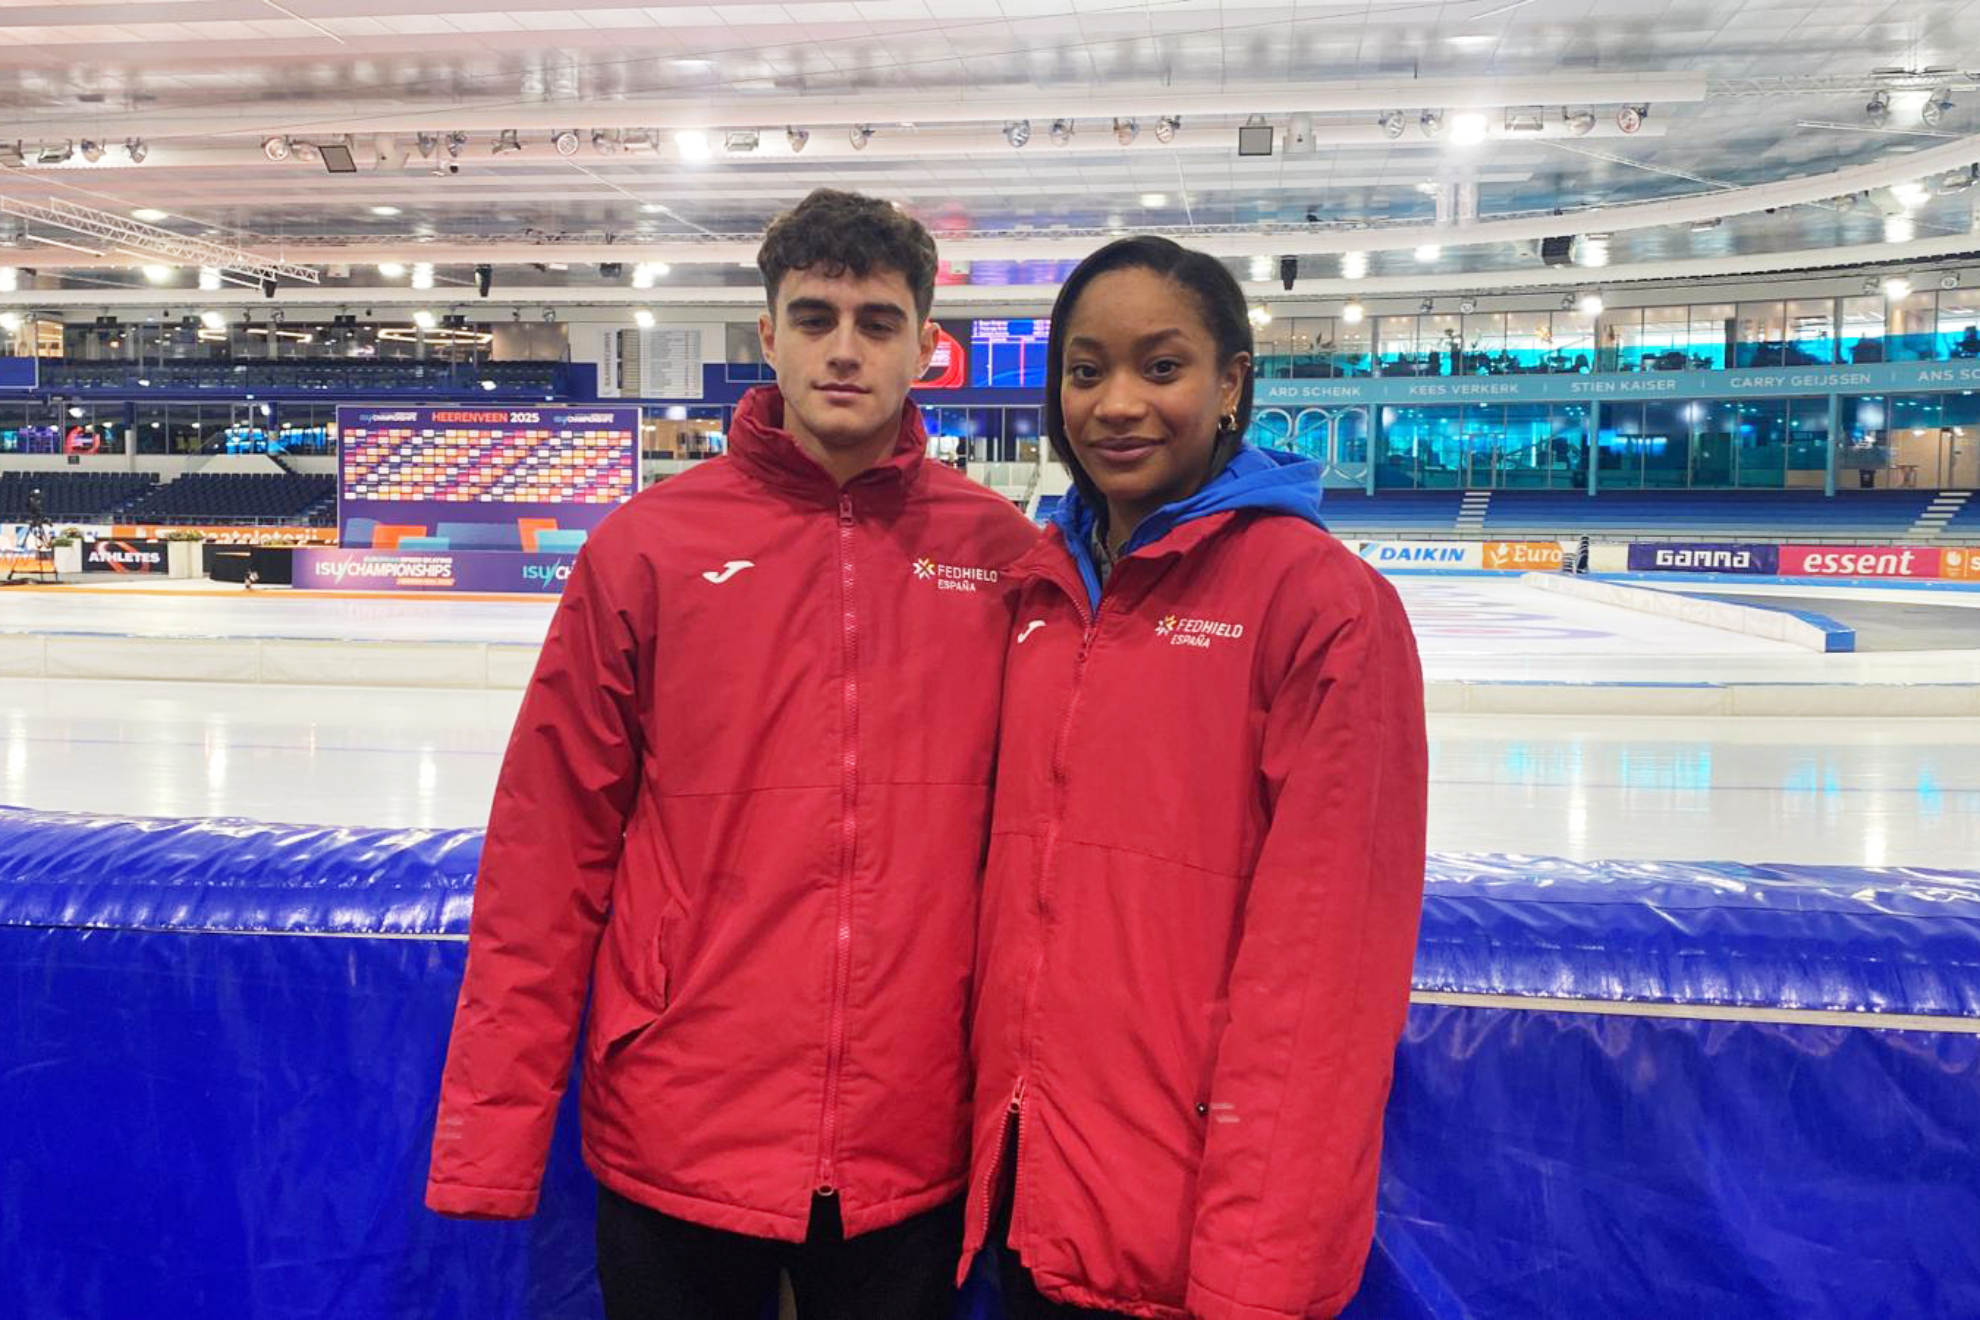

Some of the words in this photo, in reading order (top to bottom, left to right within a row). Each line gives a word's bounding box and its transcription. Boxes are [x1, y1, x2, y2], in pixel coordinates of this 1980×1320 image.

[1730, 376, 1786, 388] CARRY
[1791, 373, 1871, 387] GEIJSSEN
[1918, 370, 1954, 381] ANS
[1269, 386, 1298, 397] ARD
[1301, 386, 1361, 397] SCHENK
[1410, 385, 1446, 396] KEES
[1451, 383, 1519, 395] VERKERK
[1571, 381, 1615, 393] STIEN
[1620, 379, 1676, 392] KAISER
[431, 411, 508, 423] HEERENVEEN
[510, 411, 540, 423] 2025
[88, 552, 160, 563] ATHLETES
[1379, 546, 1465, 562] DAIKIN
[1803, 550, 1915, 576] essent
[938, 564, 998, 583] FEDHIELO
[938, 579, 976, 592] ESPAÑA
[1177, 618, 1243, 639] FEDHIELO
[1170, 634, 1211, 648] ESPAÑA
